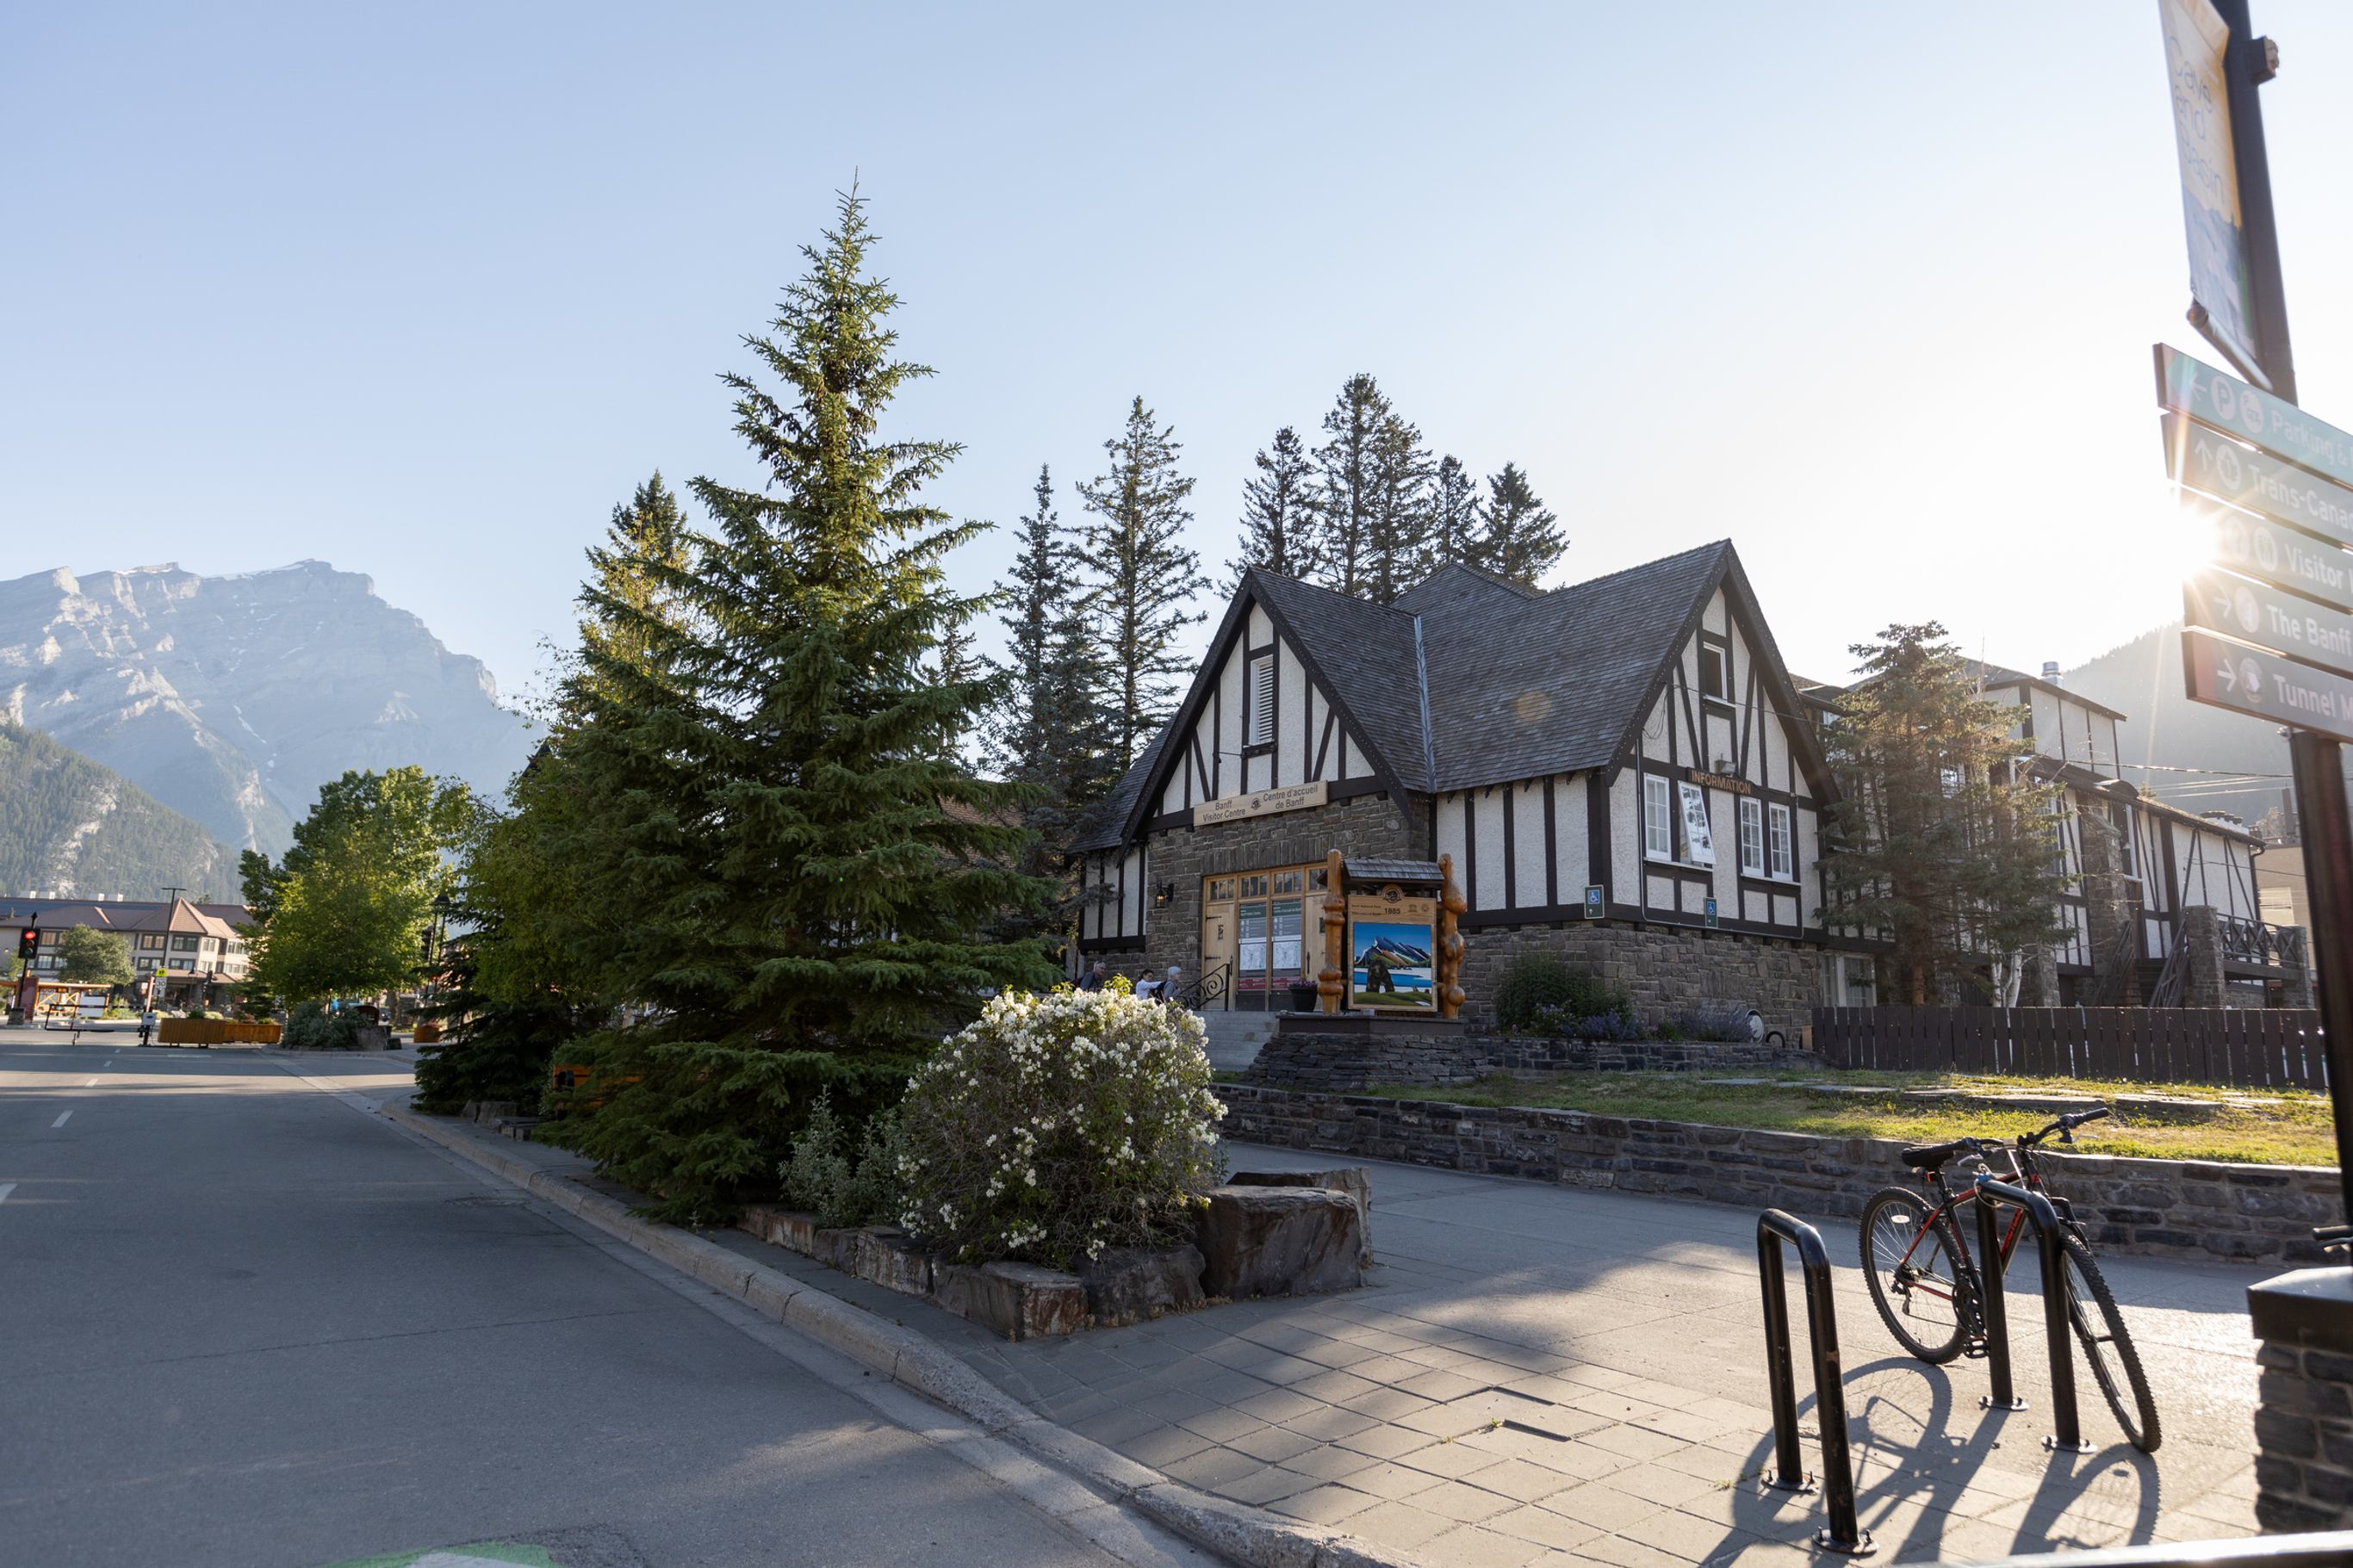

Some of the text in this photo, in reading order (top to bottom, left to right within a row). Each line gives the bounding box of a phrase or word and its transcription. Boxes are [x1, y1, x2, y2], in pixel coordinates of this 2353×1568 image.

[2168, 35, 2213, 114] Cave
[2174, 84, 2206, 140] and
[2270, 408, 2335, 467] Parking
[2336, 442, 2349, 467] &
[2284, 543, 2344, 591] Visitor
[2266, 604, 2352, 657] The Banff
[2273, 673, 2337, 718] Tunnel
[1263, 784, 1318, 802] Centre d'accueil
[1276, 796, 1305, 809] de Banff
[1691, 769, 1751, 795] INFORMATION
[1202, 809, 1246, 821] Visitor Centre
[1215, 800, 1232, 810] Banff
